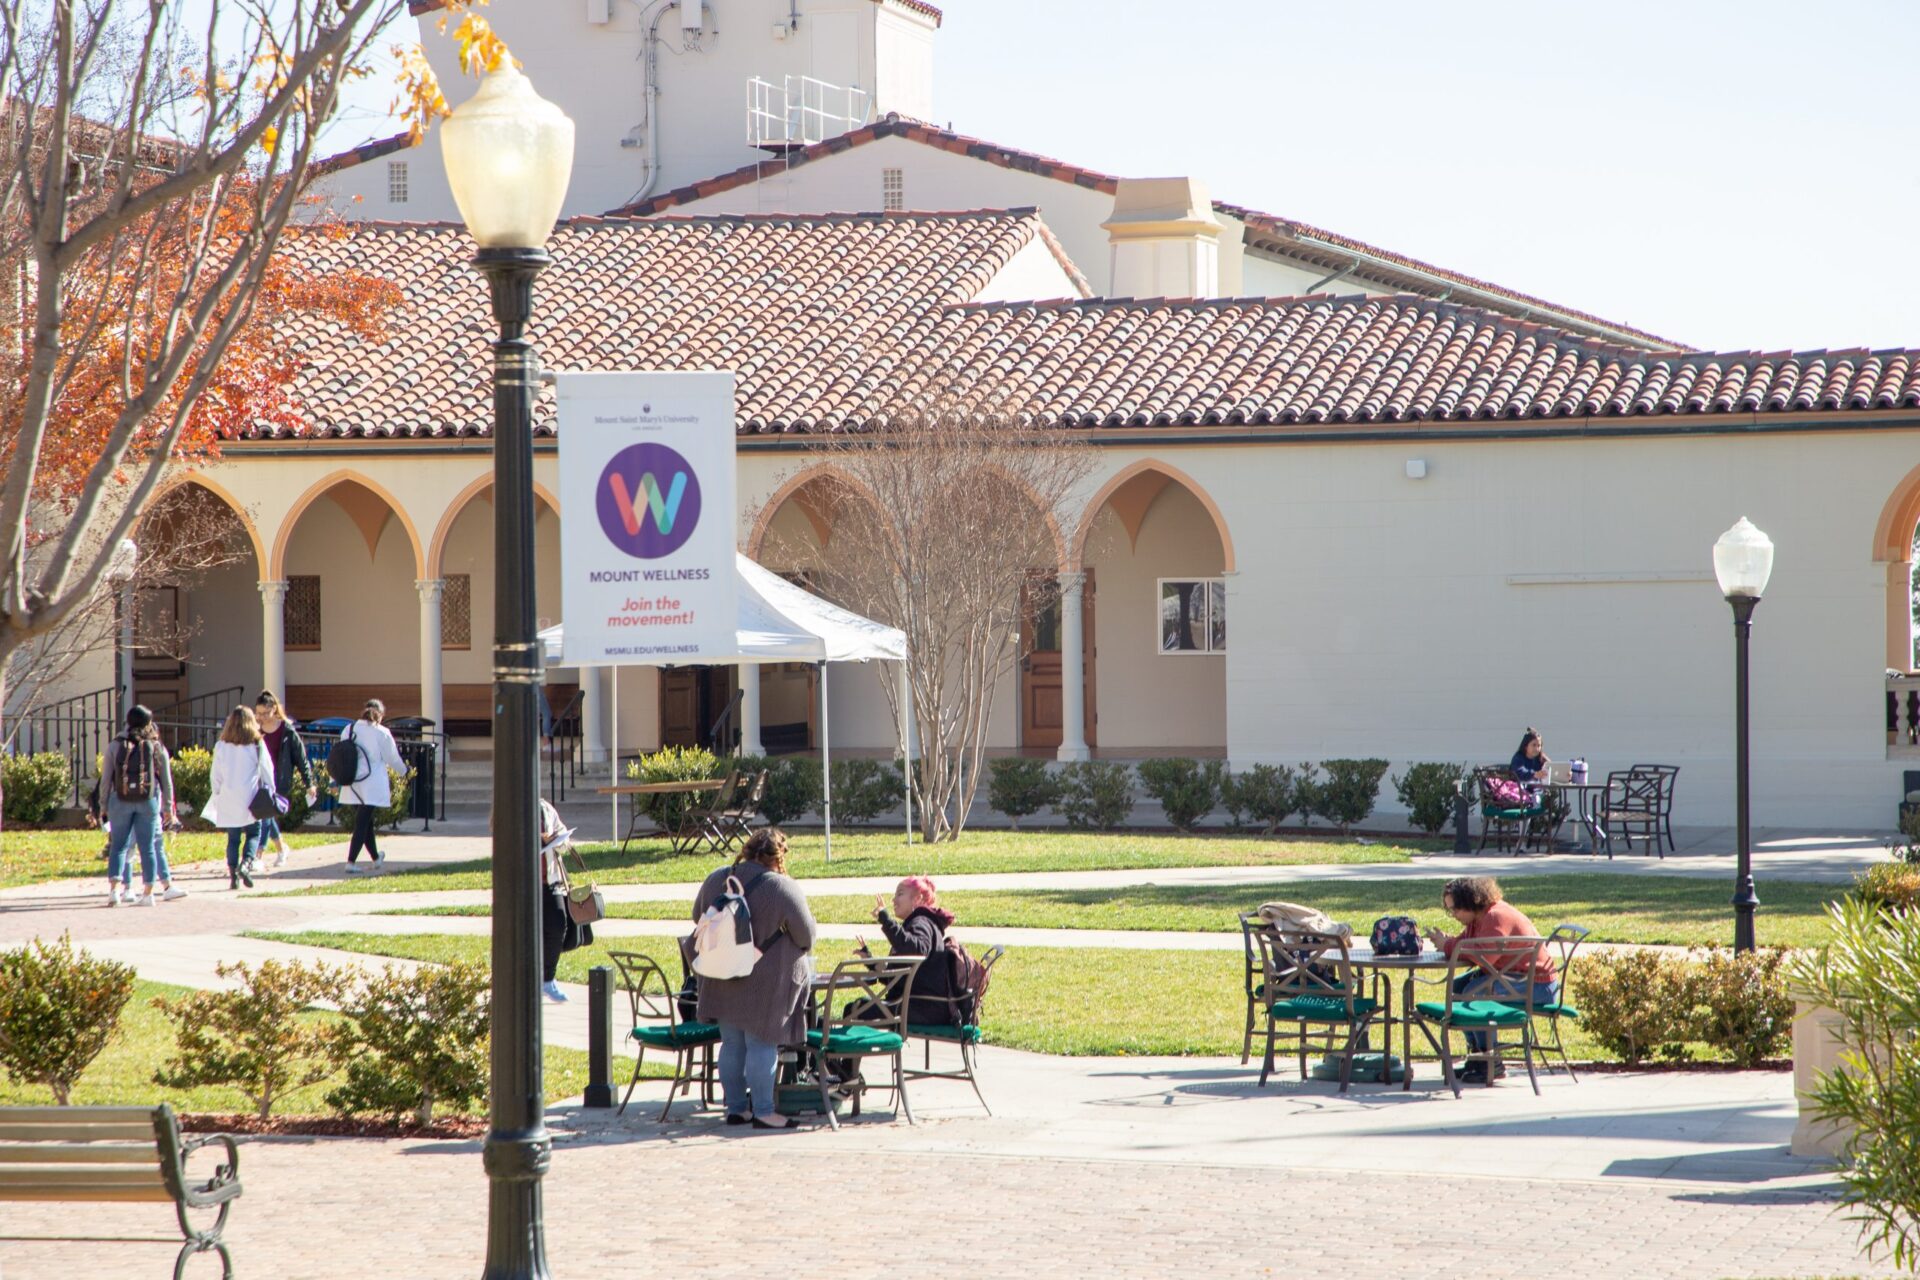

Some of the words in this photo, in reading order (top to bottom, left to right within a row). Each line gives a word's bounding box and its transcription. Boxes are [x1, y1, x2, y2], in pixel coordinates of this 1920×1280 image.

[594, 416, 618, 424] Mount
[619, 416, 638, 424] Saint
[663, 415, 699, 425] University
[590, 570, 640, 583] MOUNT
[642, 568, 710, 581] WELLNESS
[621, 597, 653, 612] Join
[655, 596, 681, 610] the
[607, 611, 694, 627] movement!
[605, 644, 699, 655] MSMU.EDU/WELLNESS
